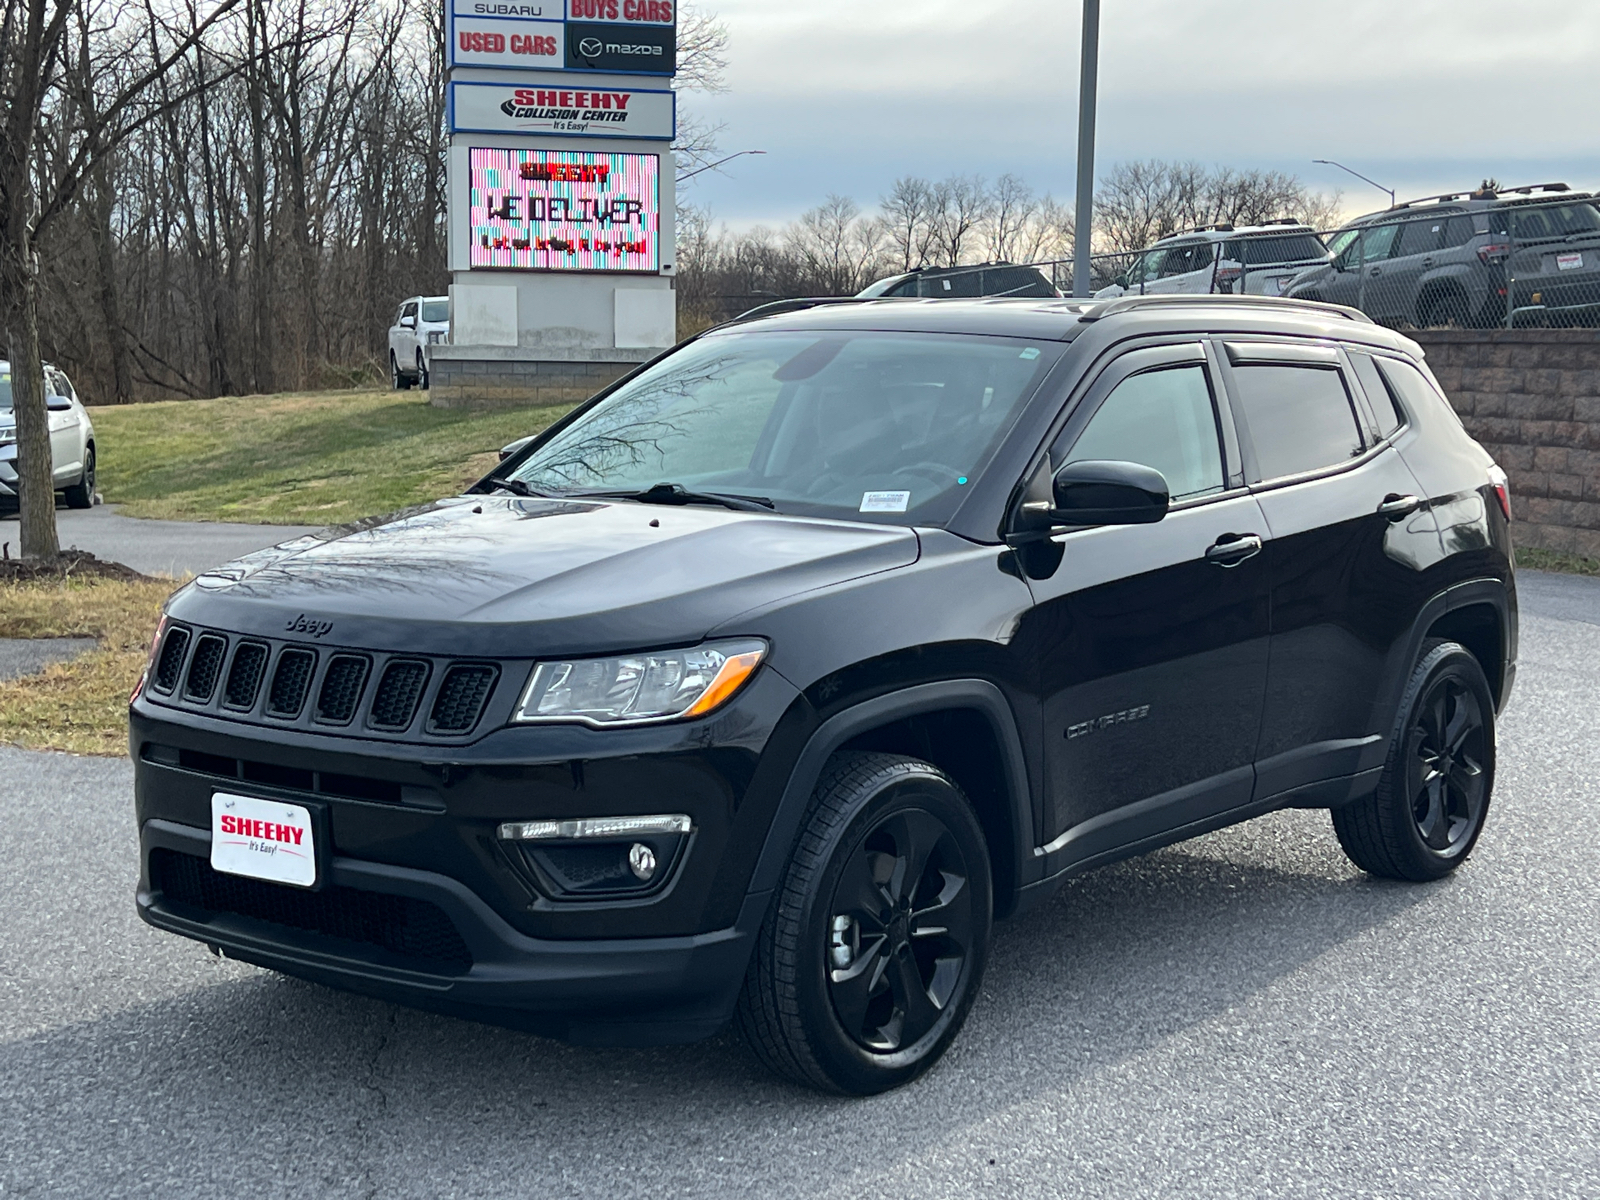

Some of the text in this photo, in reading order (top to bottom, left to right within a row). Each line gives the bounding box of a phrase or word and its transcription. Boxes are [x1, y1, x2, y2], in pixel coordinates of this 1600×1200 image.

[474, 4, 542, 16] SUBARU
[571, 0, 673, 22] BUYS CARS
[459, 31, 557, 56] USED CARS
[605, 43, 663, 56] mazda
[514, 89, 631, 110] SHEEHY
[515, 107, 628, 122] COLLISION CENTER
[553, 121, 589, 132] It's Easy!
[519, 162, 610, 182] SHEEHY
[487, 195, 643, 224] WE DELIVER
[285, 613, 334, 639] Jeep
[1064, 704, 1150, 740] COMPASS
[220, 814, 304, 846] SHEEHY
[248, 840, 278, 856] It's Easy!
